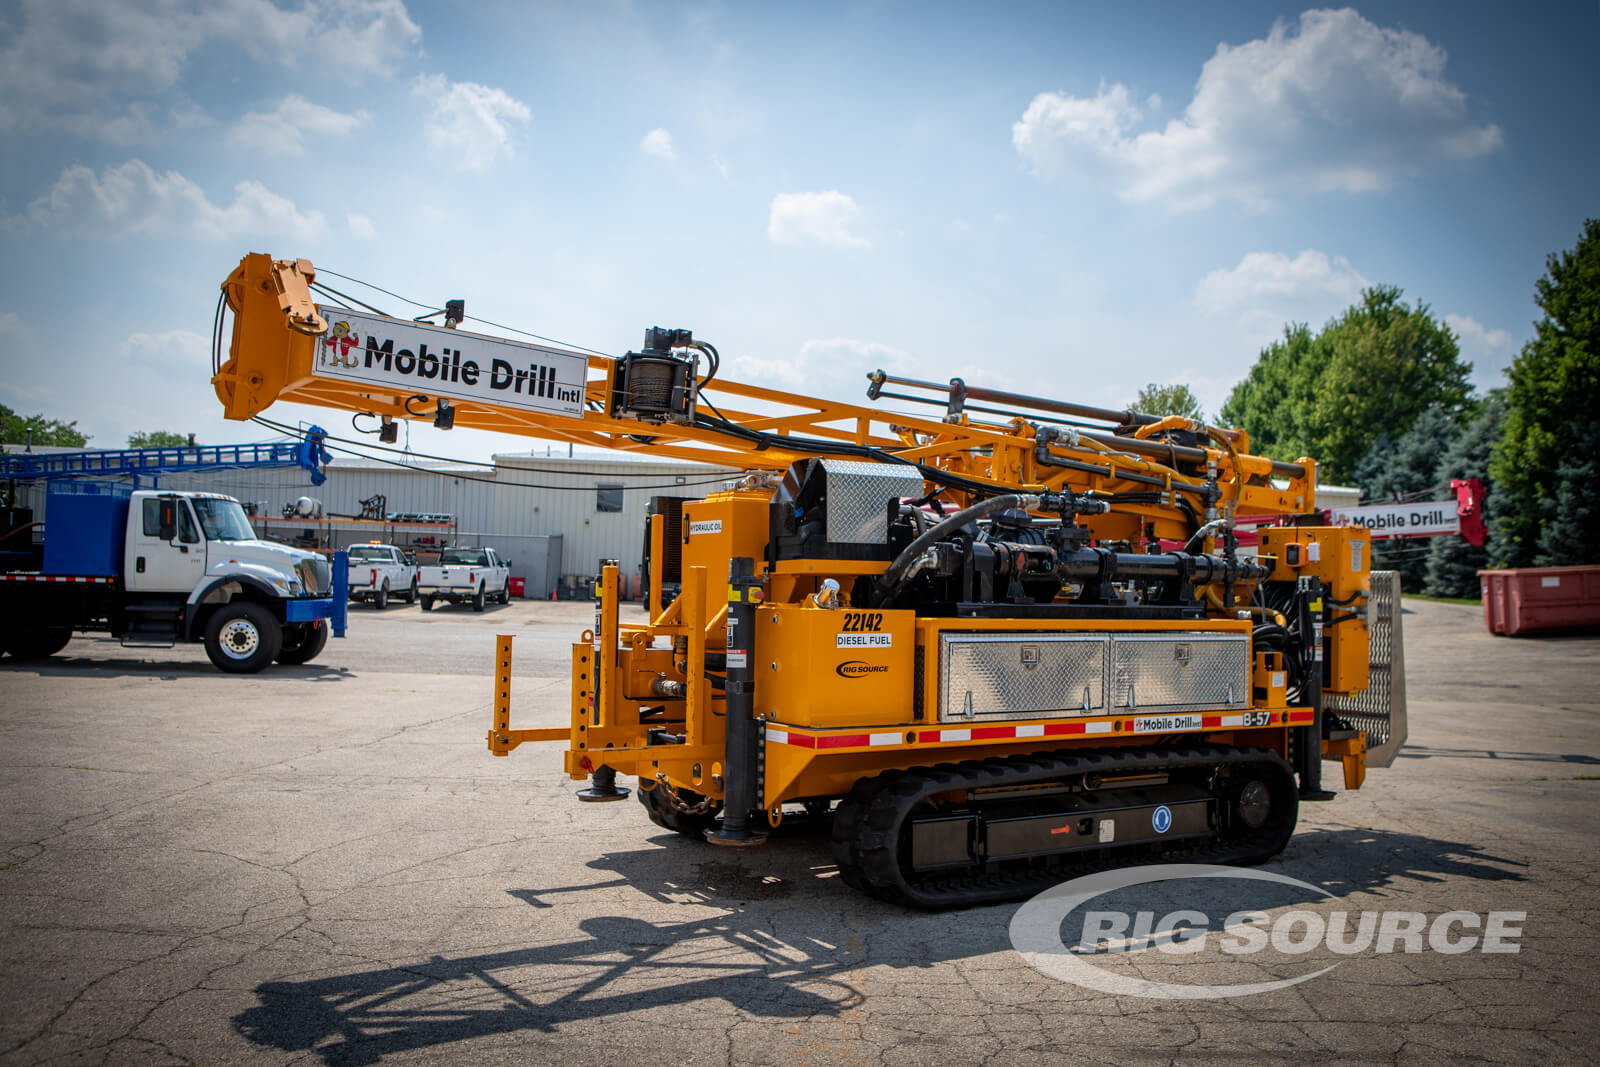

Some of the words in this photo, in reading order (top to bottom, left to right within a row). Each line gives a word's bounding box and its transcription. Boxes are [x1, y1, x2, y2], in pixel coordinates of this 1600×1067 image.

[364, 335, 480, 386] Mobile
[490, 358, 556, 399] Drill
[557, 387, 581, 403] Intl
[1353, 513, 1405, 529] Mobile
[1410, 511, 1443, 526] Drill
[842, 612, 883, 632] 22142
[837, 636, 867, 646] DIESEL
[870, 636, 891, 645] FUEL
[857, 665, 889, 673] SOURCE
[1143, 717, 1173, 731] Mobile
[1175, 716, 1192, 729] Drill
[1243, 711, 1271, 727] B-57
